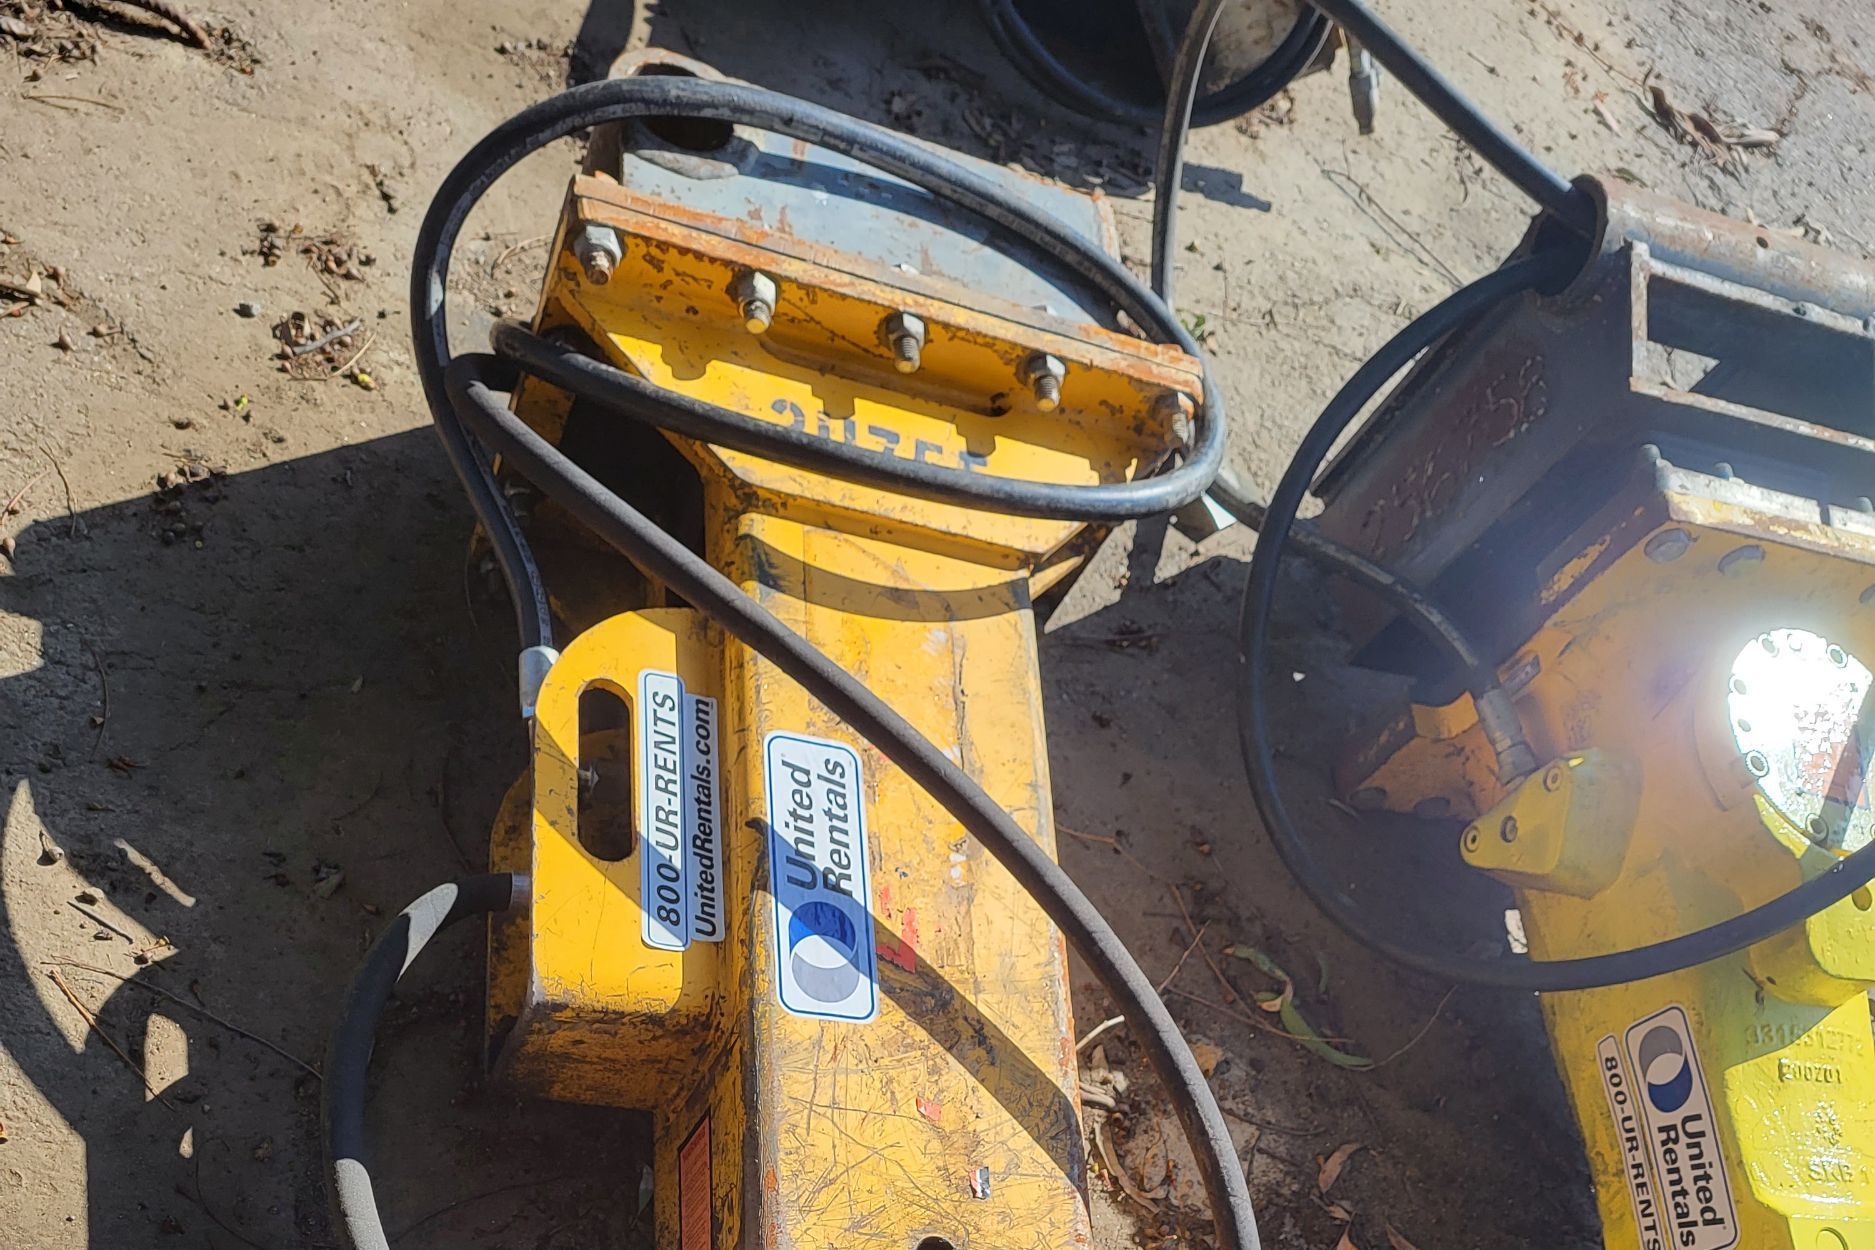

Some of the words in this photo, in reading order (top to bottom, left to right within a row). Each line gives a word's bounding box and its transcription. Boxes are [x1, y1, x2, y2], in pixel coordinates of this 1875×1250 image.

[652, 690, 681, 927] 800-UR-RENTS
[690, 698, 718, 938] UnitedRentals.com
[781, 759, 818, 891] United
[817, 758, 853, 897] Rentals
[1657, 1124, 1699, 1247] Rentals
[1681, 1113, 1725, 1227] United
